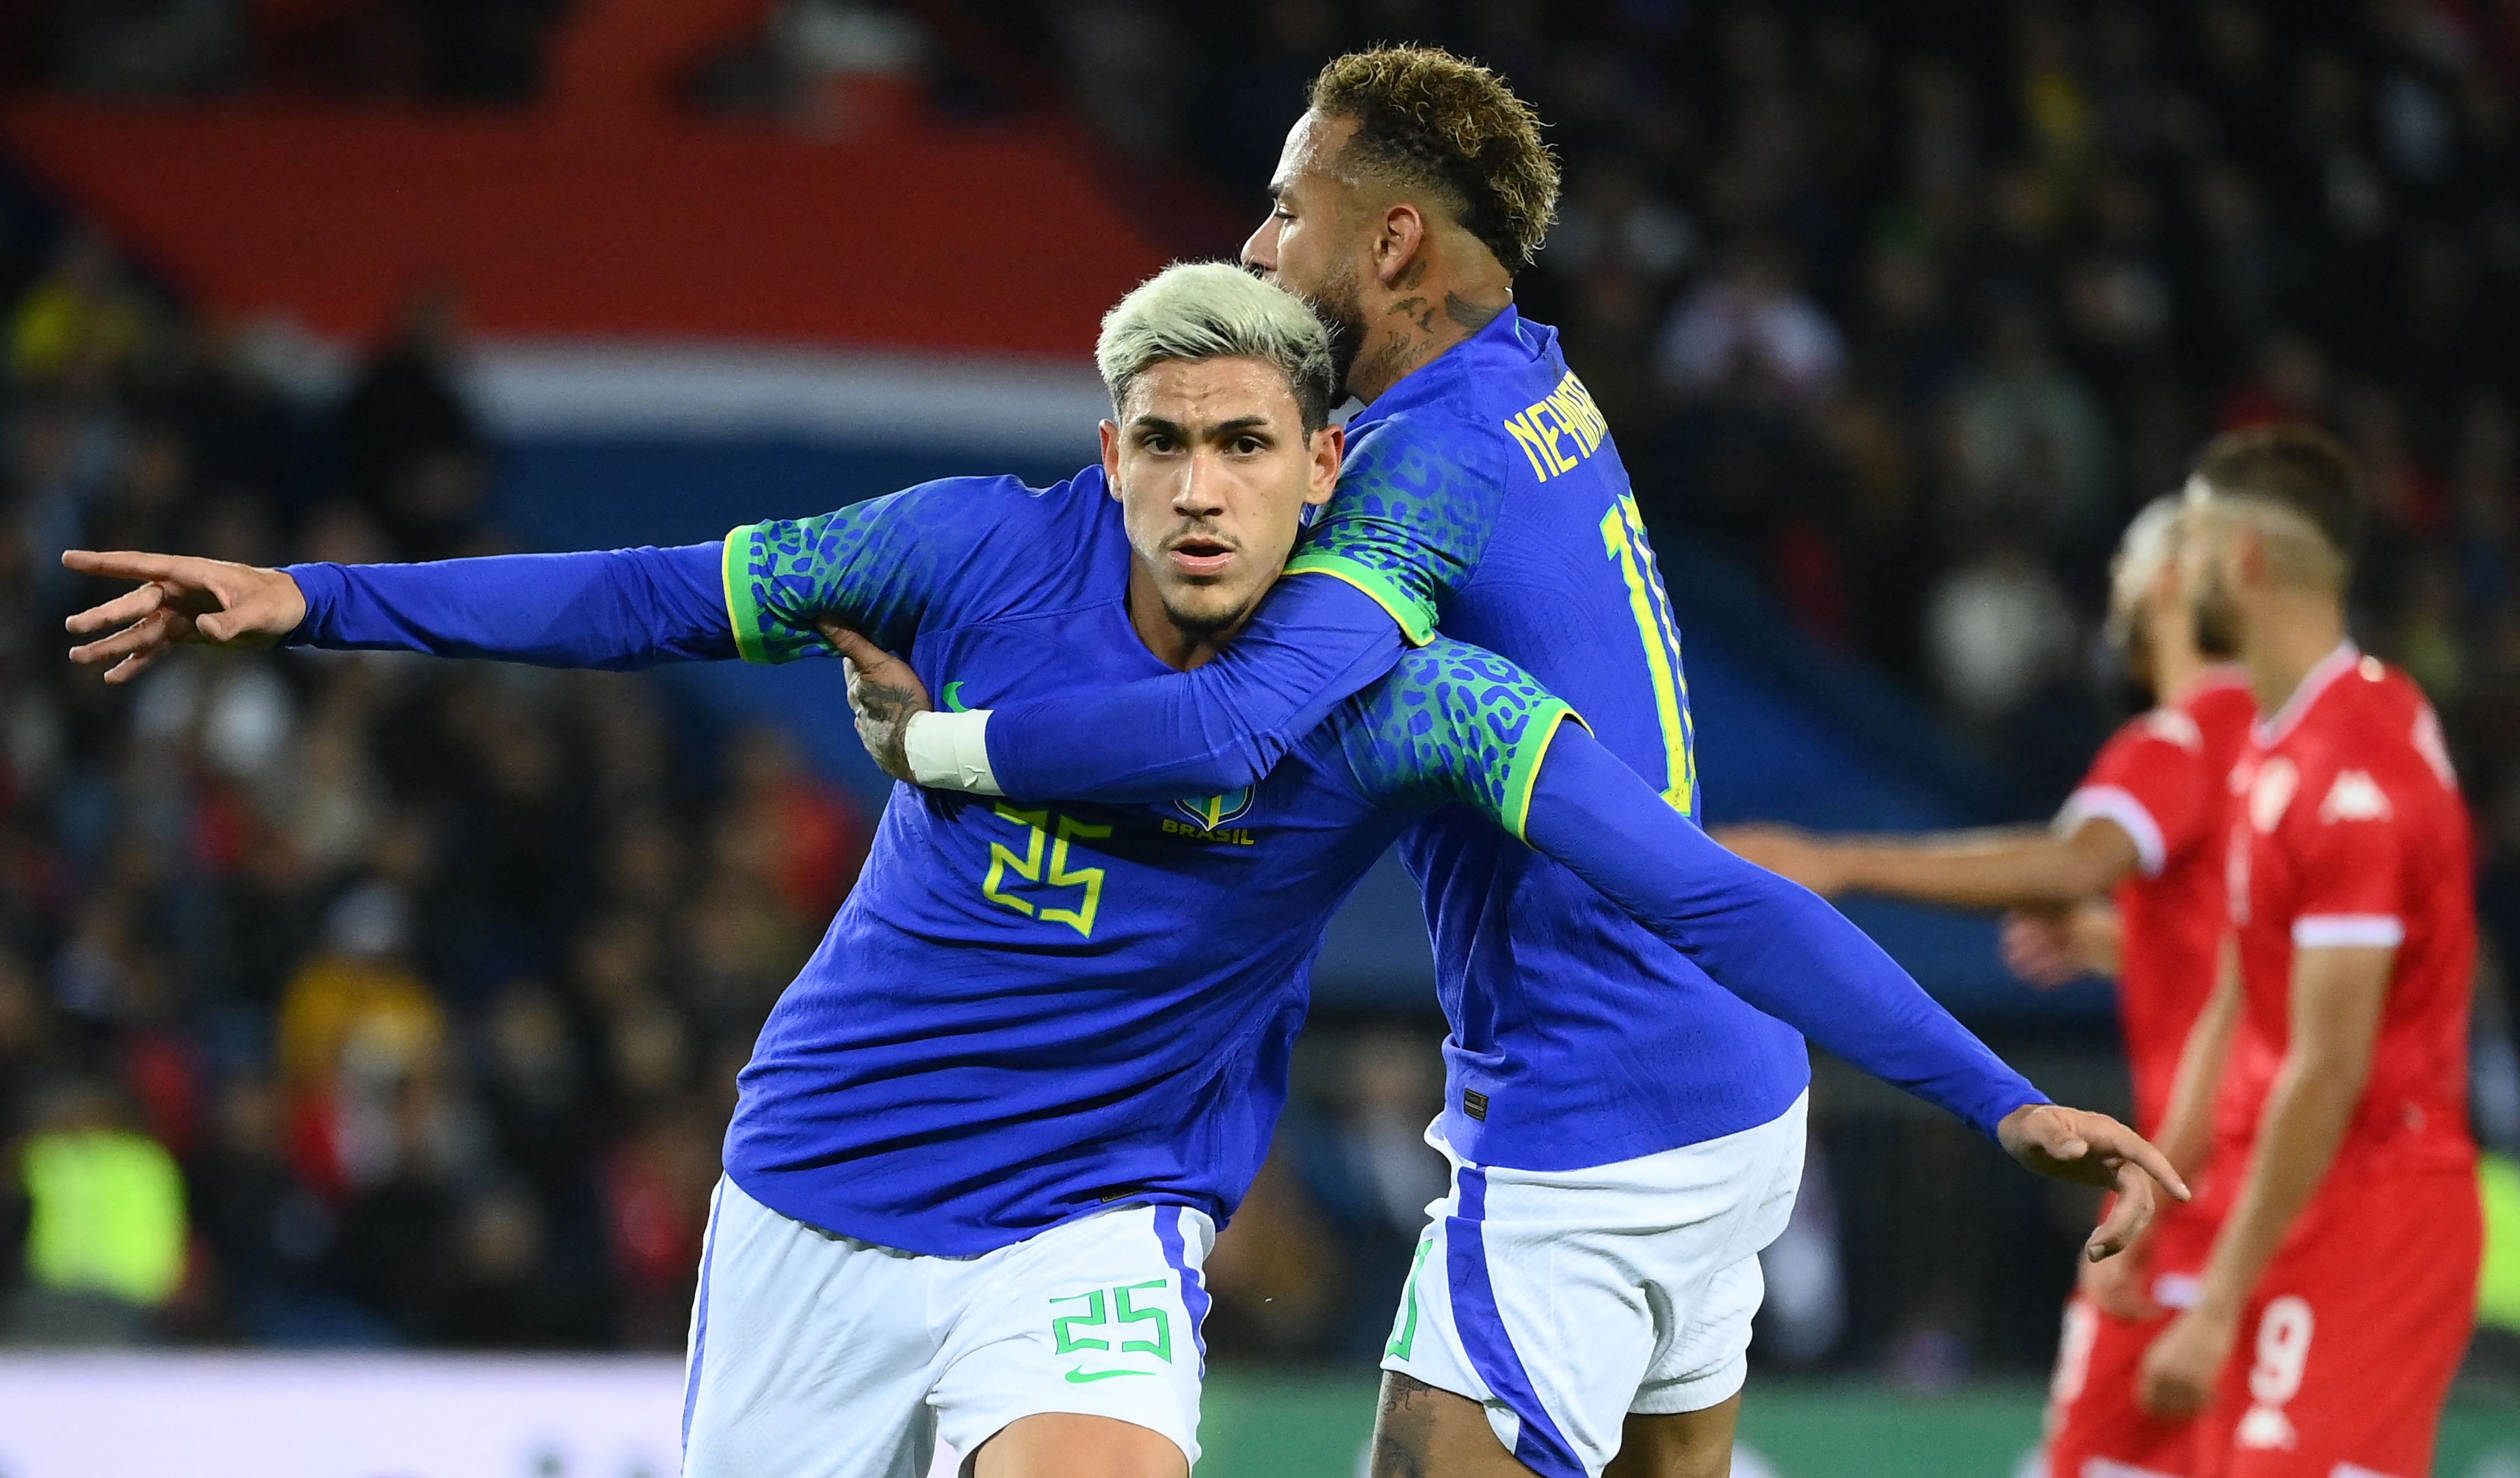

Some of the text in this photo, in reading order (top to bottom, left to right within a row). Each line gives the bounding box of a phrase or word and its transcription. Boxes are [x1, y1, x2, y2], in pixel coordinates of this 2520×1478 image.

[982, 801, 1113, 939] 25
[1162, 819, 1255, 845] BRASIL
[1049, 1279, 1172, 1364] 25
[2249, 1295, 2316, 1408] 9
